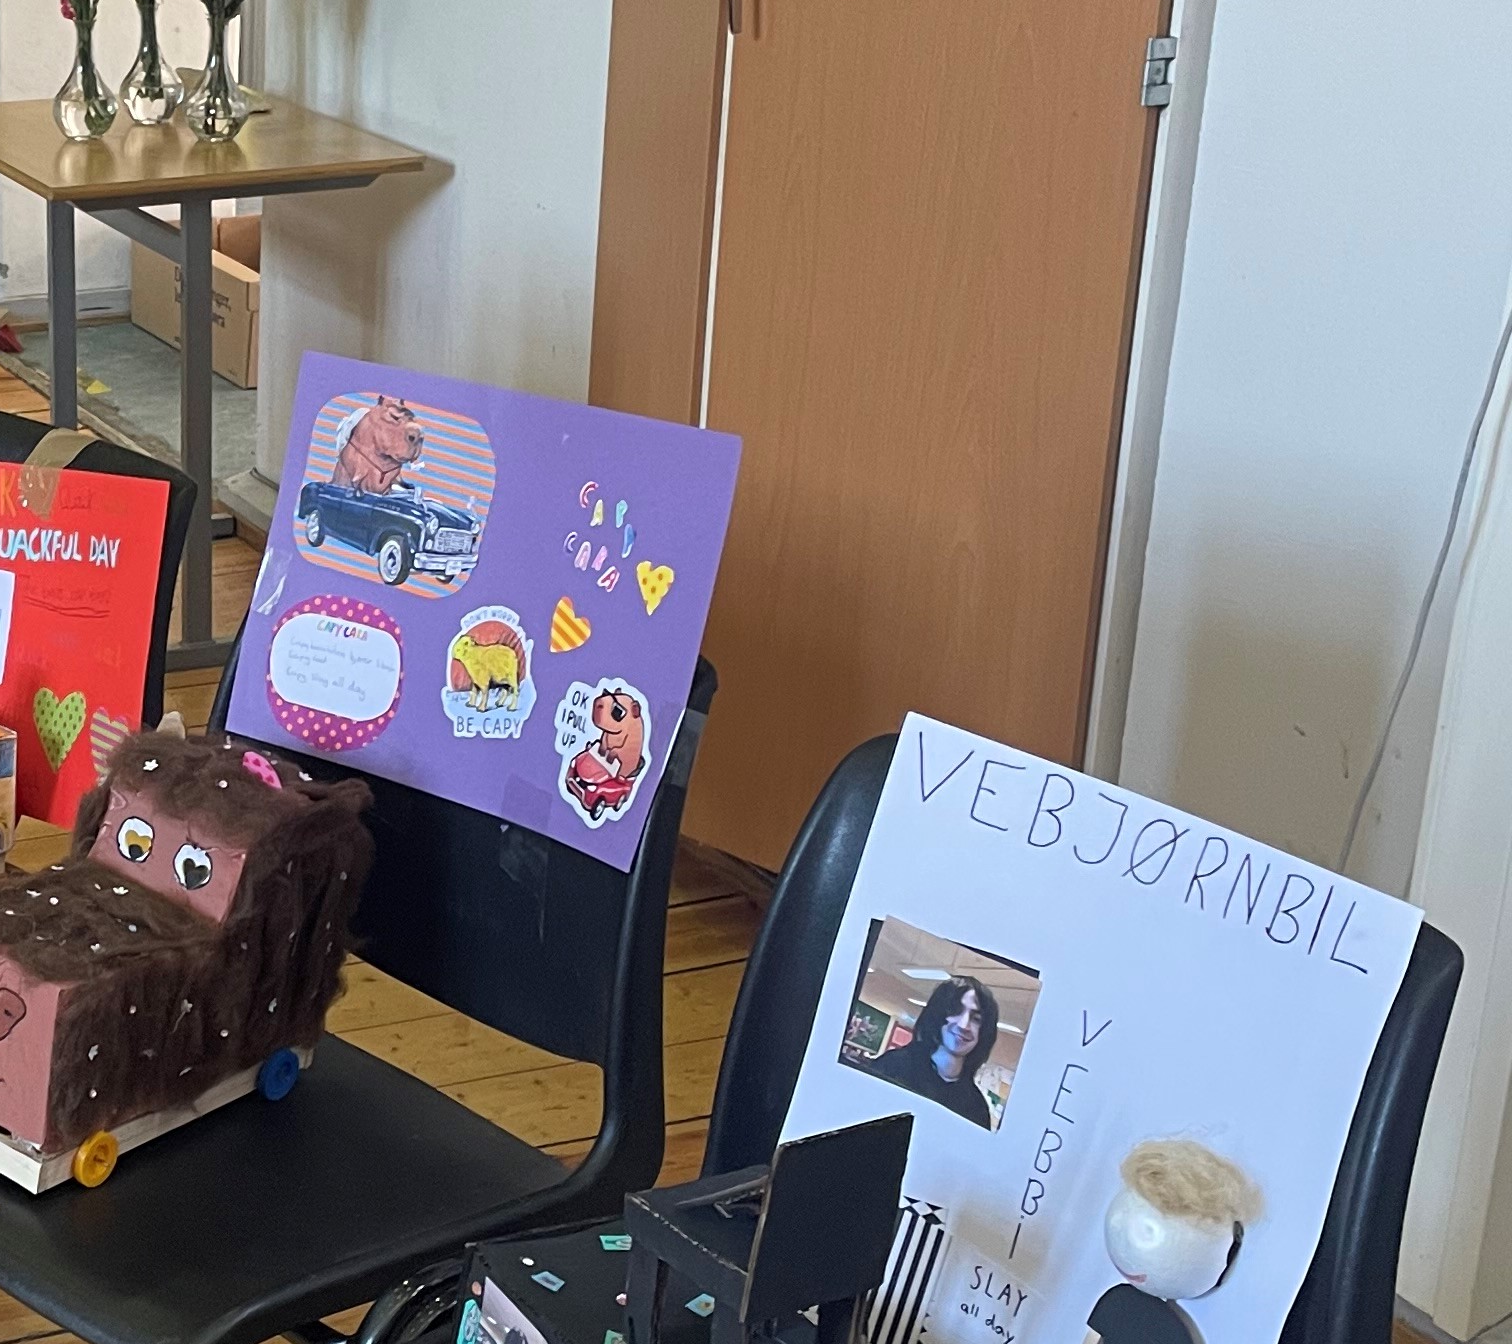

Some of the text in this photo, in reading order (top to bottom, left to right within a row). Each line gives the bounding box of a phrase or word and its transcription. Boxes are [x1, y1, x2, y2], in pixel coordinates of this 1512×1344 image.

[88, 532, 121, 569] DAY
[571, 690, 589, 709] OK
[456, 716, 521, 735] BE CAPY
[562, 731, 577, 748] UP
[917, 730, 1371, 976] VEBJØRNBIL
[969, 1265, 1028, 1318] SLAY
[960, 1303, 980, 1318] all
